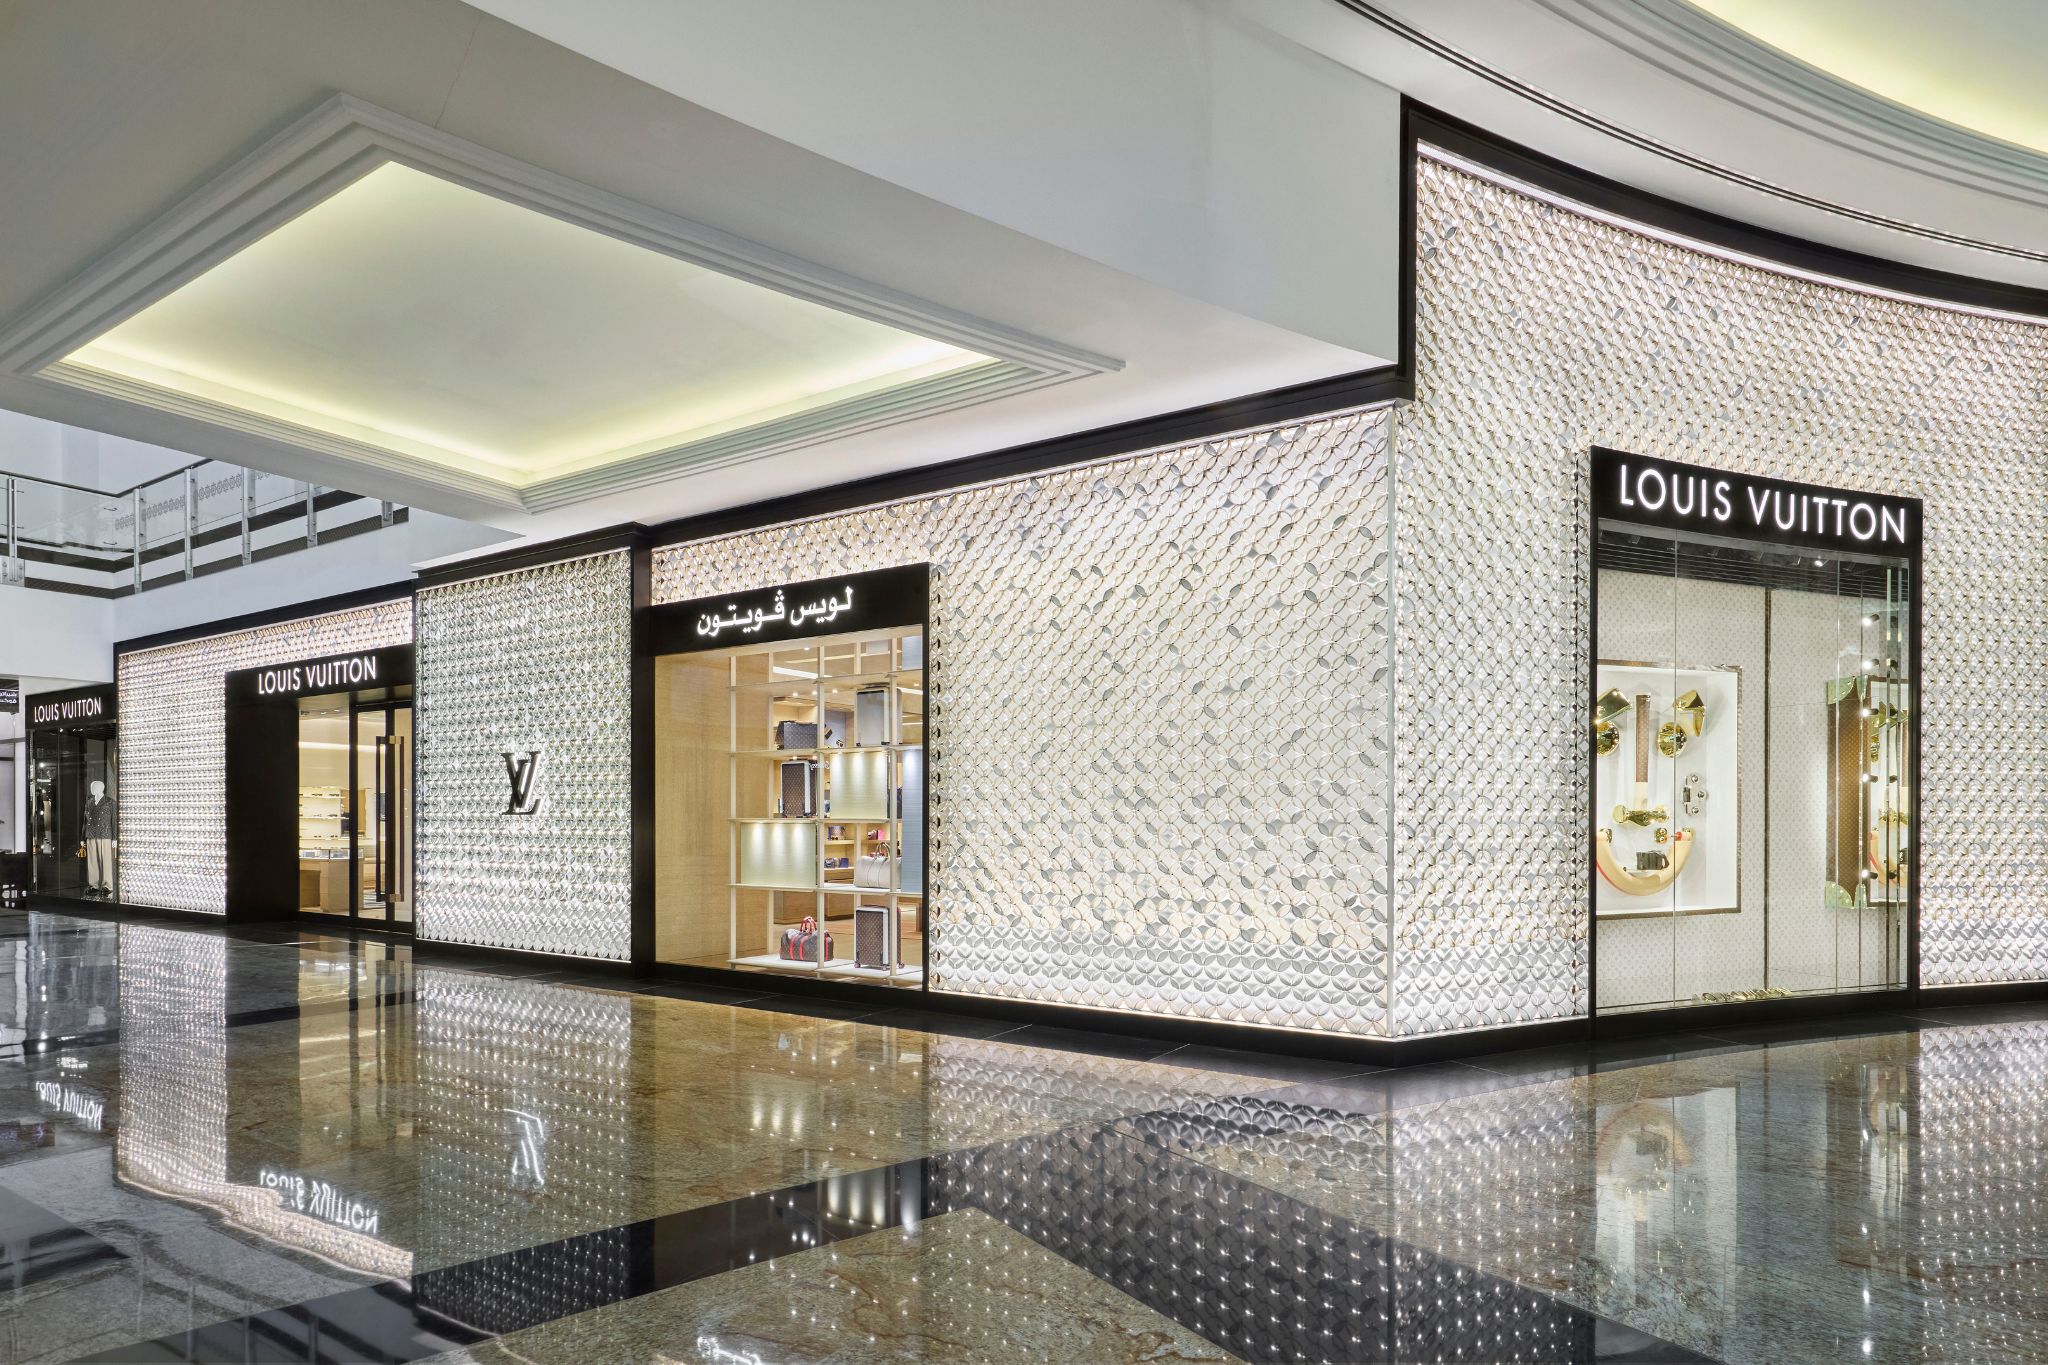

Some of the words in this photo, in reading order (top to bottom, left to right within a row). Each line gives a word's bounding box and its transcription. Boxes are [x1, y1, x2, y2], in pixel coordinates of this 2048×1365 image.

[1619, 463, 1733, 522] LOUIS
[1747, 485, 1907, 545] VUITTON
[790, 585, 853, 626] لويس
[258, 666, 302, 695] LOUIS
[305, 655, 376, 689] VUITTON
[34, 702, 60, 723] LOUIS
[61, 696, 103, 720] VUITTON
